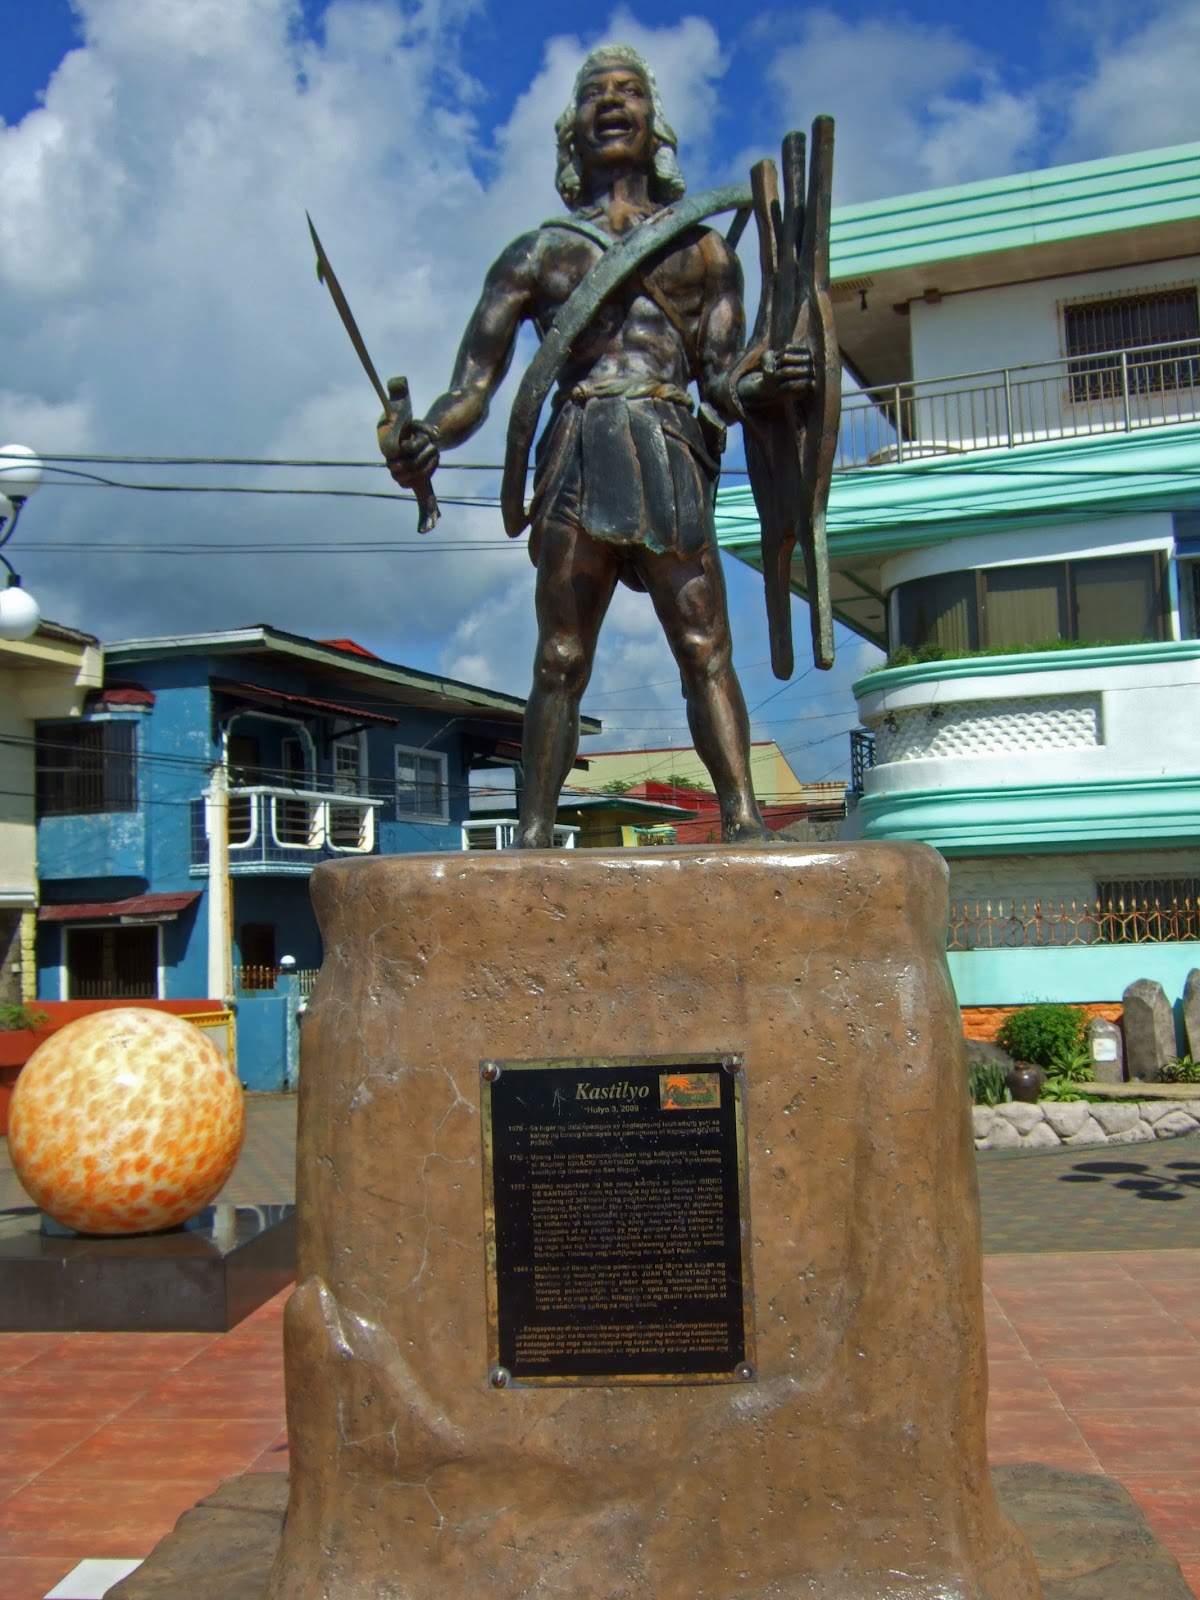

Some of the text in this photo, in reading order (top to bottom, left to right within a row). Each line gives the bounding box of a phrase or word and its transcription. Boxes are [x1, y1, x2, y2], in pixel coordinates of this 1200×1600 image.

[575, 1081, 650, 1102] Kastilyo
[587, 1105, 610, 1114] Hulyo
[620, 1104, 639, 1113] 2009
